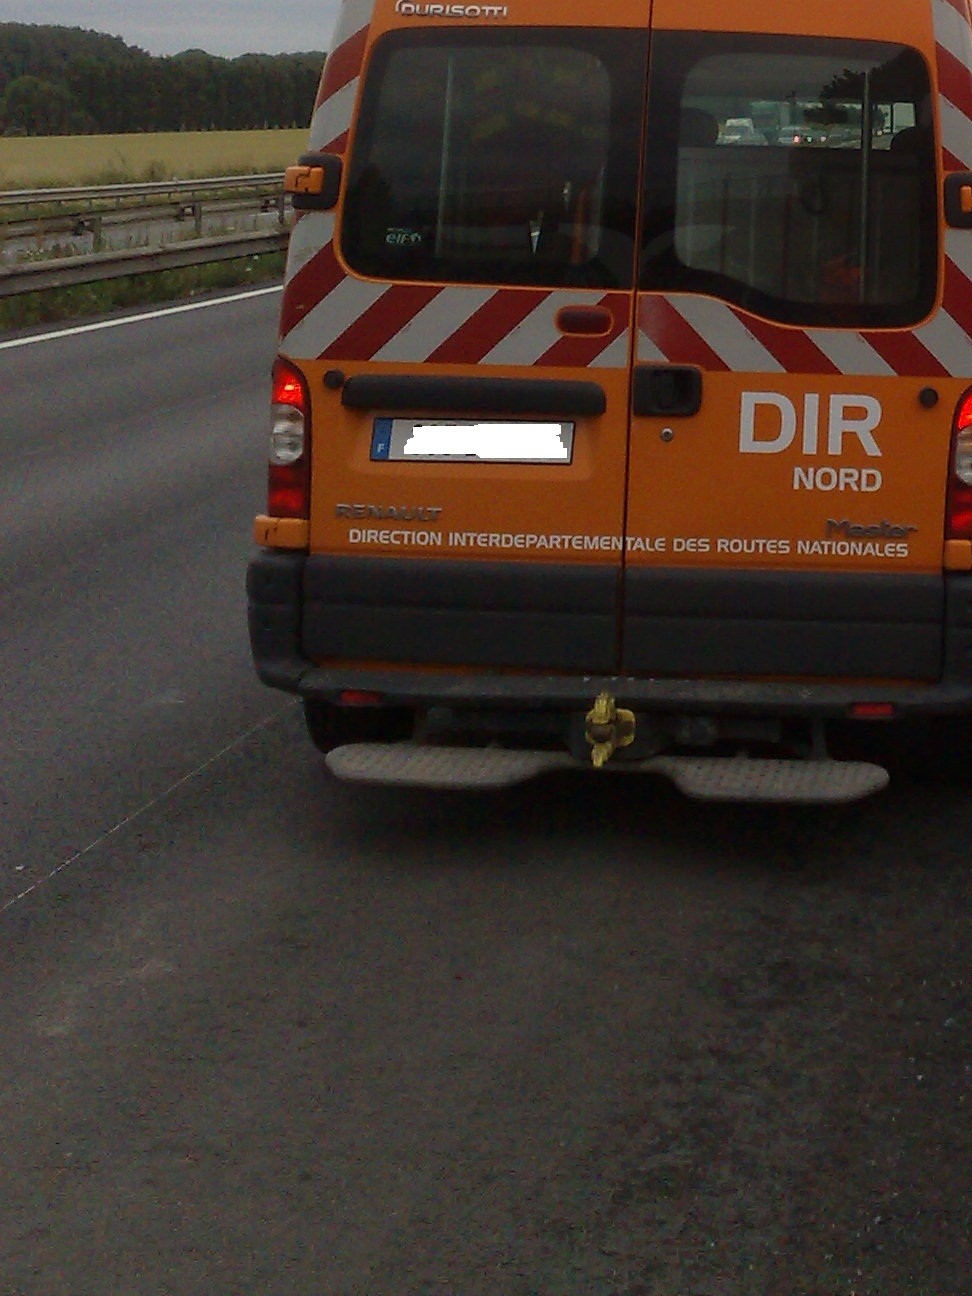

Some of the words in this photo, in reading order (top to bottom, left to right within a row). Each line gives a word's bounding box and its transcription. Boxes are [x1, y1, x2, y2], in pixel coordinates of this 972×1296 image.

[738, 391, 883, 456] DIR
[377, 443, 385, 453] F
[793, 466, 883, 492] NORD
[335, 504, 442, 521] RENAULT
[825, 518, 919, 538] Master
[349, 528, 442, 546] DIRECTION
[449, 532, 666, 552] INTERDEPARTEMENTALE
[672, 537, 710, 553] DES
[716, 538, 791, 554] ROUTES
[796, 540, 909, 558] NATIONALES
